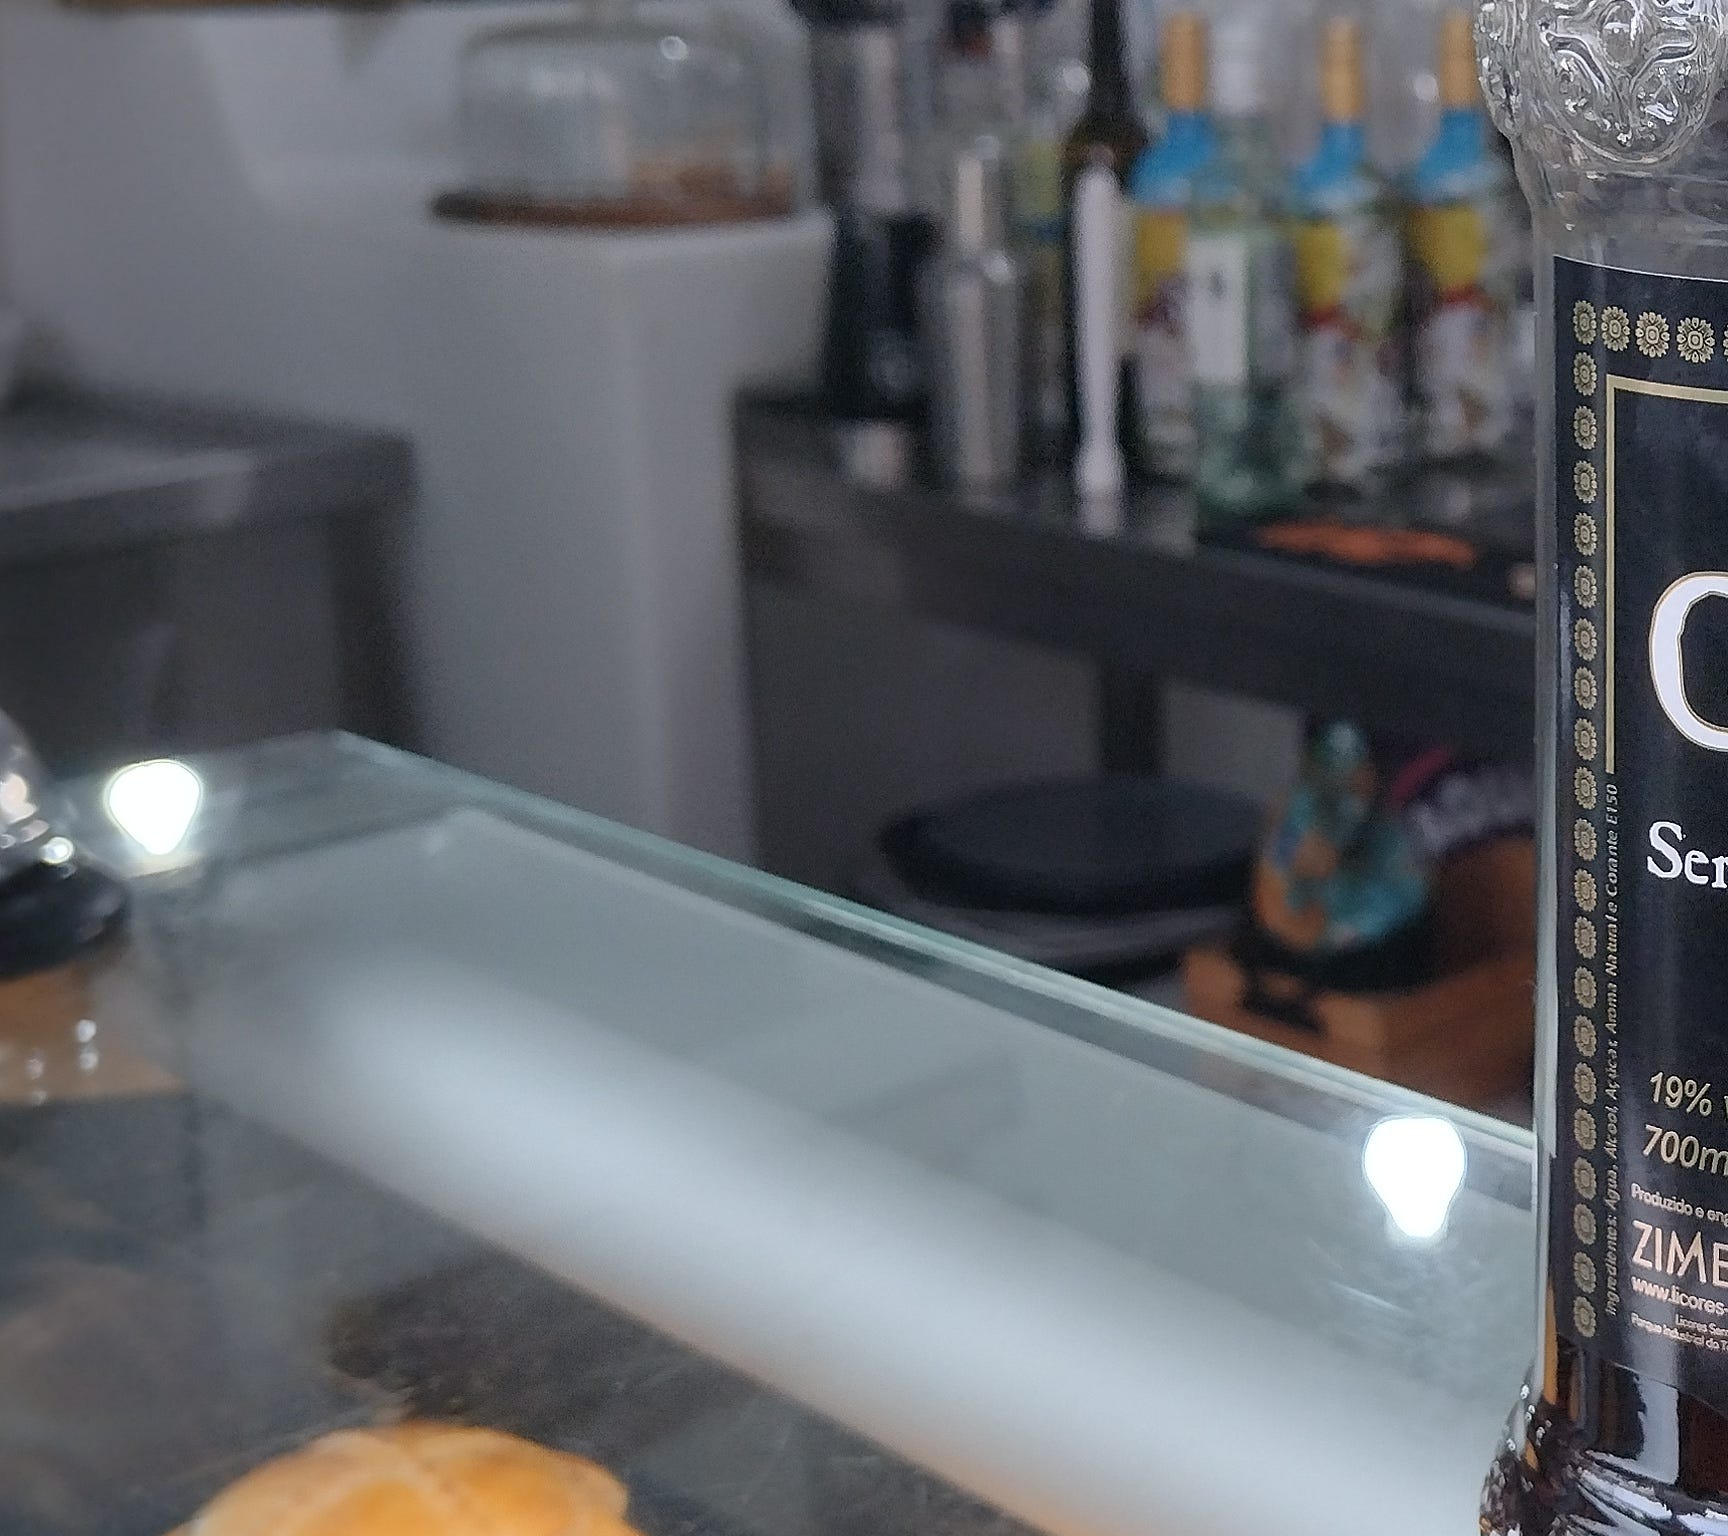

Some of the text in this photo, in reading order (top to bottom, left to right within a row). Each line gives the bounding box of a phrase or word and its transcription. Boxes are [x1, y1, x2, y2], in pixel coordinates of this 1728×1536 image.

[1604, 784, 1619, 826] E150
[1649, 1071, 1713, 1117] 19%
[1631, 1182, 1693, 1217] Produzido
[1695, 1206, 1704, 1218] e
